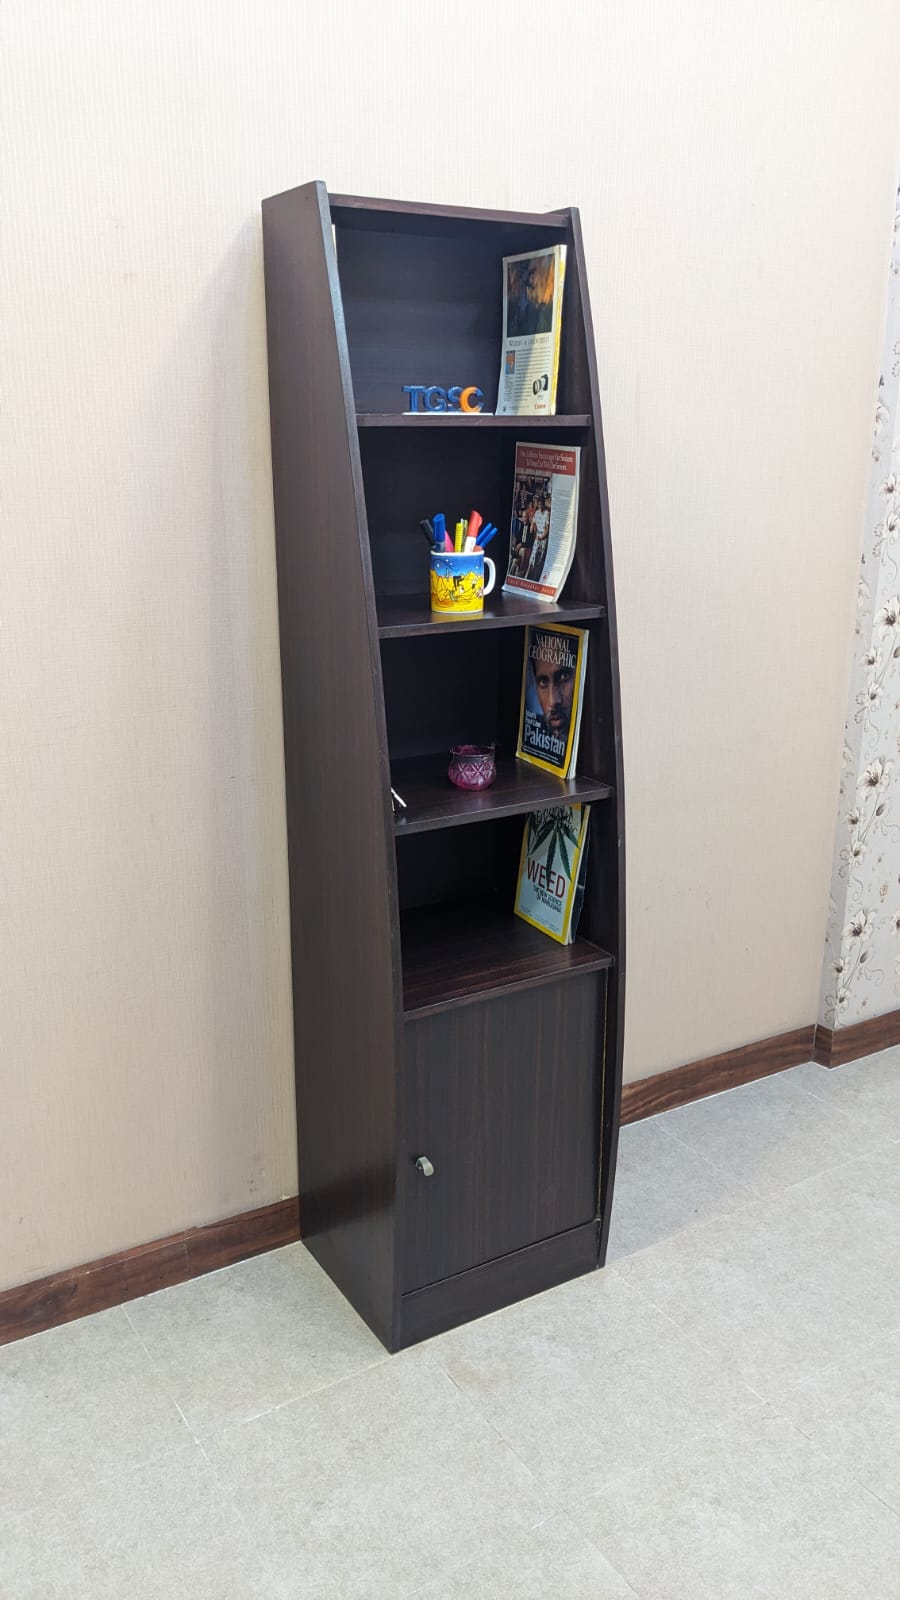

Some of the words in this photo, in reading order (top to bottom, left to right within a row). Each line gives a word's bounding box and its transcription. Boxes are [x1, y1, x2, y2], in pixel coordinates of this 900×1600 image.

[402, 385, 484, 413] TGSC
[528, 644, 577, 669] GEOGRAPHIC
[535, 633, 571, 653] NATIONAL
[524, 724, 565, 756] Pakistan
[526, 857, 566, 898] WEED
